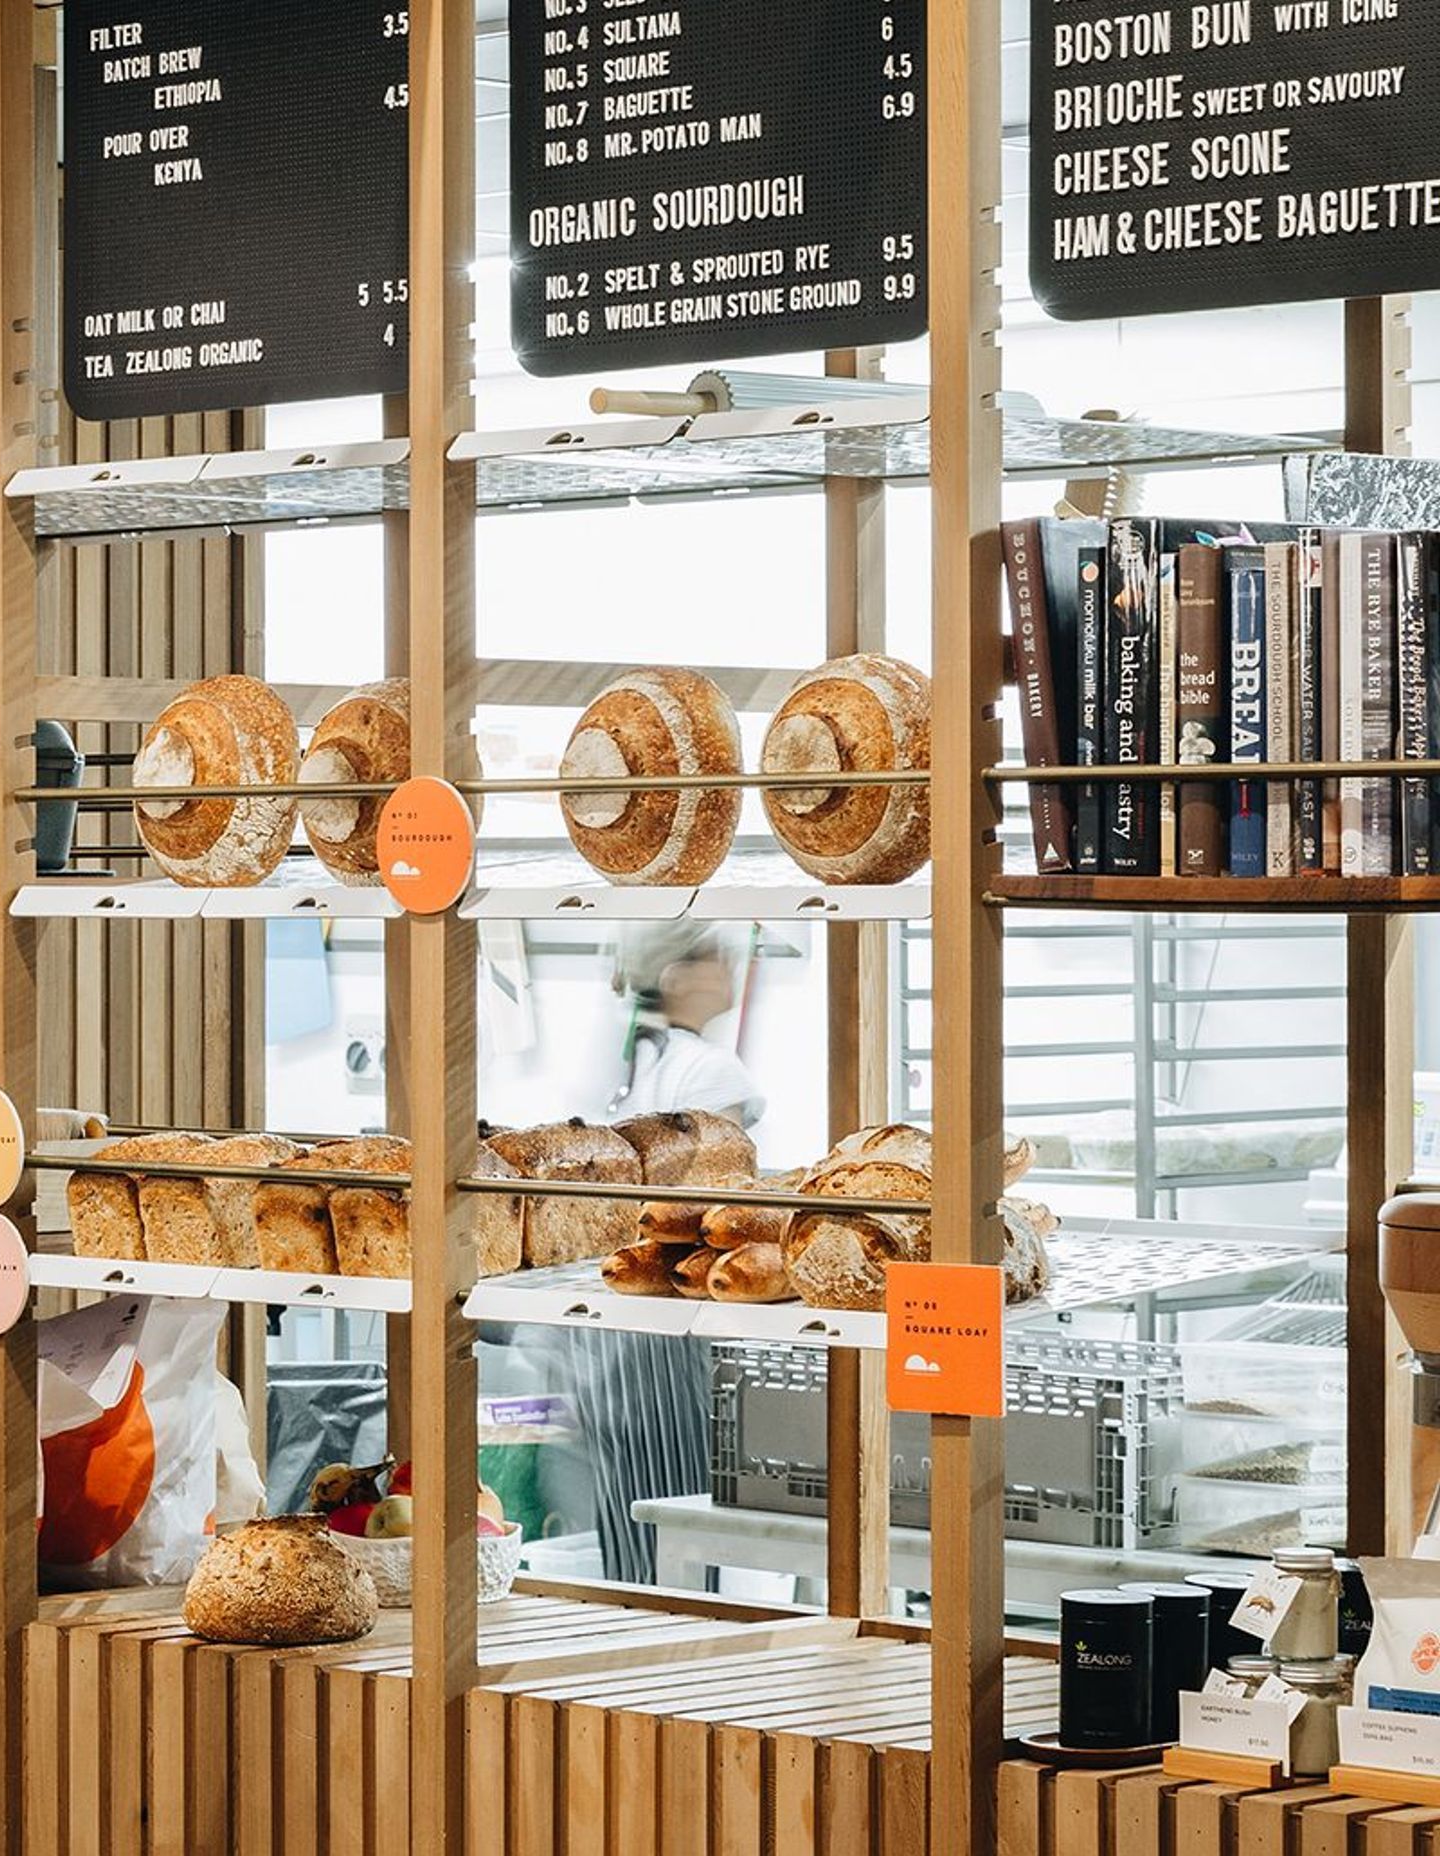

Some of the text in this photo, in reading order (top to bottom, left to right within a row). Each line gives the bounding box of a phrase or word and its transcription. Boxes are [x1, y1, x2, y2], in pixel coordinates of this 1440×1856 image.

[91, 23, 142, 51] FILTER
[384, 12, 408, 37] 3.5
[545, 12, 681, 55] NO.4 SULTANA
[882, 17, 893, 41] 6
[1055, 11, 1171, 66] BOSTON
[1192, 0, 1250, 49] BUN
[1274, 1, 1328, 32] WITH
[104, 46, 202, 83] BATCH BREW
[545, 51, 670, 92] NO.5 SQUARE
[884, 54, 912, 79] 4.5
[155, 79, 221, 109] ETHIOPIA
[384, 84, 408, 109] 4.5
[546, 85, 692, 129] NO.7 BAGUETTE
[883, 92, 914, 119] 6.9
[1055, 66, 1405, 131] BRIOCHE SWEET OR SAVOURY
[104, 126, 188, 158] POUR OVER
[545, 113, 761, 166] NO.8 MR. POTATO MAN
[155, 158, 202, 185] KENYA
[1055, 128, 1290, 195] CHEESE SCONE
[530, 175, 803, 247] ORGANIC SOURDOUGH
[1054, 179, 1440, 260] HAM & CHEESE BAGUETTE
[883, 234, 913, 261] 9.5
[546, 244, 829, 300] NO.2 SPELT & SPROUTED RYE
[884, 273, 915, 300] 9.9
[358, 279, 407, 306] 5 5.5
[546, 279, 861, 338] NO.6 WHOLE GRAIN STONE GROUND
[85, 300, 225, 337] OAT MILK OR CHAI
[384, 324, 394, 346] 4
[85, 338, 263, 378] TEA ZEALONG ORGANIC
[1270, 562, 1282, 590] THE
[1013, 532, 1043, 719] BOUCHON BAKERY
[1270, 593, 1283, 683] SOURDOUGH
[1368, 547, 1382, 700] THE RYE BAKER
[1083, 588, 1096, 730] momofuku milk bar
[1114, 636, 1140, 715] baking
[1180, 653, 1198, 667] the
[1180, 670, 1215, 685] bread
[1411, 644, 1426, 684] Bread
[1180, 689, 1211, 705] bible
[1302, 664, 1315, 721] WATER
[1160, 698, 1174, 765] handma
[1270, 686, 1283, 743] SCHOOL
[1118, 718, 1139, 763] and
[1112, 784, 1134, 840] astry
[1302, 780, 1314, 821] EAST
[391, 834, 452, 842] SOURDOUGH
[905, 1325, 988, 1337] SQUARE LOAF
[1344, 1618, 1373, 1631] ZEAL
[1076, 1652, 1133, 1666] ZEALONG
